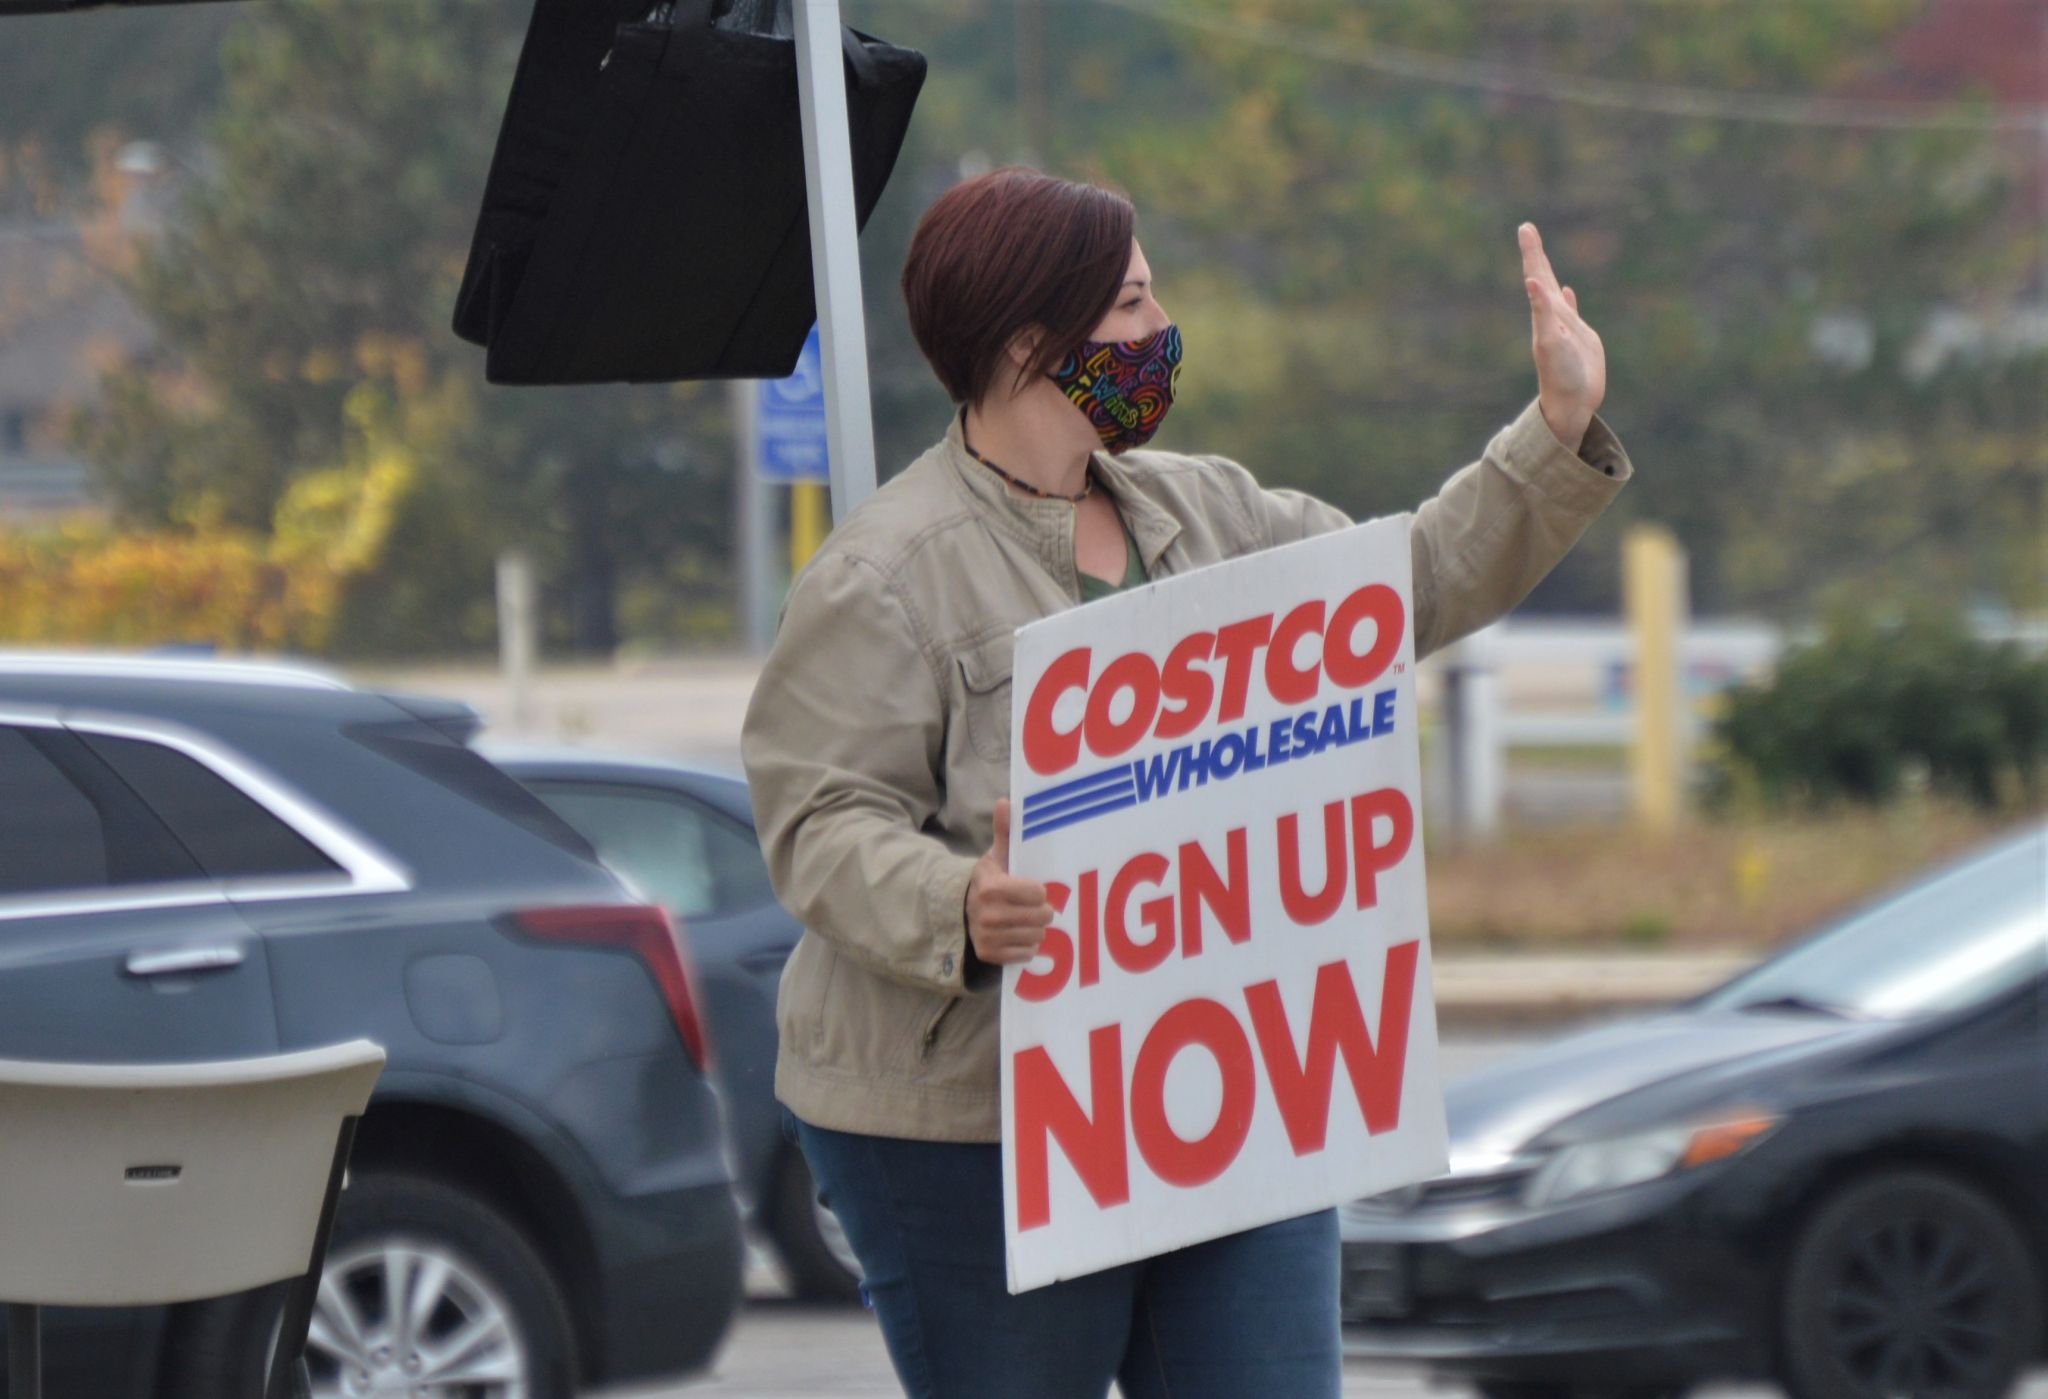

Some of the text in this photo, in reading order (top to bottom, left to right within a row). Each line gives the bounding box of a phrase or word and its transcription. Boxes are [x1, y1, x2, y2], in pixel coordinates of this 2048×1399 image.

[1023, 583, 1405, 775] COSTCO
[1134, 687, 1397, 803] WHOLESALE
[1014, 787, 1414, 1002] SIGN UP
[1014, 940, 1419, 1232] NOW
